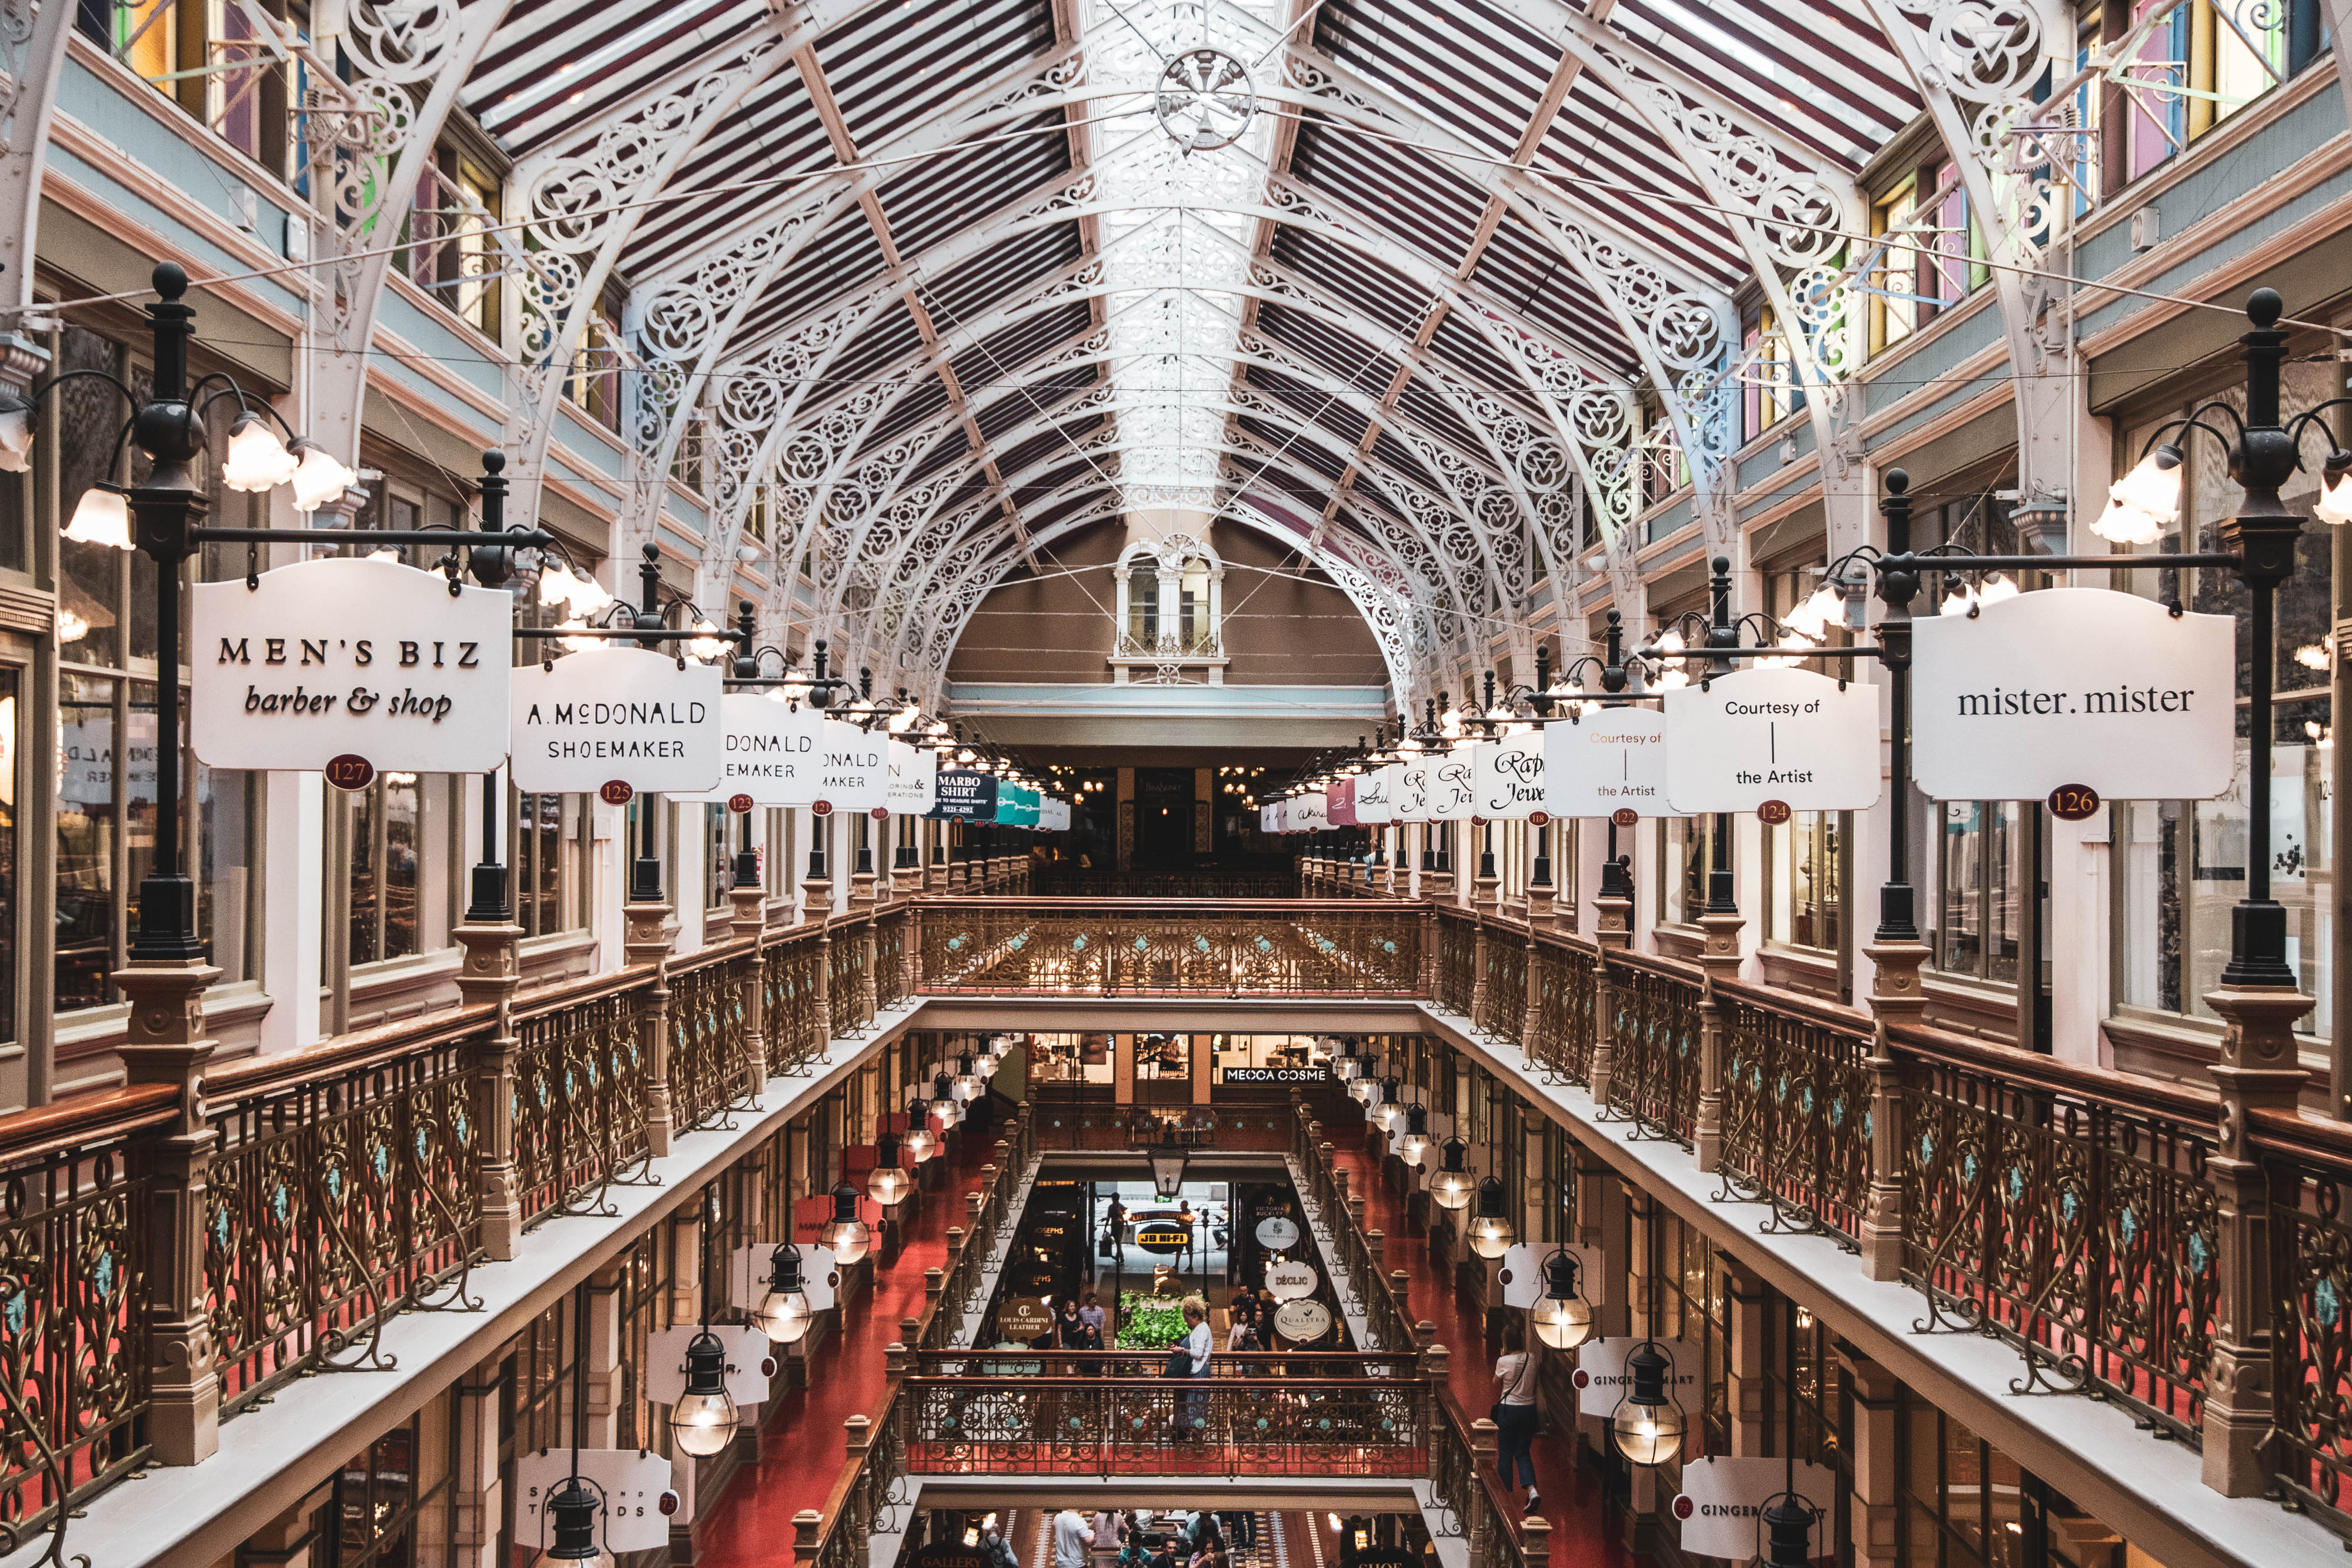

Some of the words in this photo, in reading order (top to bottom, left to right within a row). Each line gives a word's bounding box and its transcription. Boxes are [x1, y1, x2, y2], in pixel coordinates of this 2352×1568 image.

[219, 638, 372, 666] MEN'S
[399, 641, 479, 667] BIZ
[245, 685, 336, 714] barber
[346, 687, 379, 714] &
[388, 687, 452, 724] shop
[1726, 701, 1799, 716] Courtesy
[1804, 700, 1820, 714] of
[1590, 733, 1646, 745] Courtesy
[1650, 733, 1662, 743] of
[548, 741, 684, 758] SHOEMAKER
[332, 763, 366, 780] 127
[1495, 751, 1545, 783] Rap
[938, 776, 981, 787] MARBO
[1736, 771, 1762, 784] the
[1768, 769, 1813, 784] Artist
[914, 779, 924, 789] &
[604, 785, 630, 800] 125
[941, 787, 976, 797] SHIRT
[1598, 785, 1616, 796] the
[1621, 785, 1655, 796] Artist
[731, 798, 752, 809] 123
[815, 803, 830, 813] 121
[2054, 791, 2093, 813] 126
[1760, 805, 1788, 818] 124
[1532, 814, 1544, 823] 118
[1616, 813, 1635, 823] 122
[1227, 1069, 1275, 1081] MECCA
[1278, 1069, 1326, 1081] COSME
[1275, 1275, 1308, 1285] DÉCLIC
[1593, 1376, 1636, 1385] GINGE
[529, 1503, 644, 1516] THADS
[662, 1499, 675, 1510] 73
[1678, 1503, 1689, 1512] 72
[1700, 1504, 1760, 1517] GINGER
[921, 1557, 983, 1567] GALLERY
